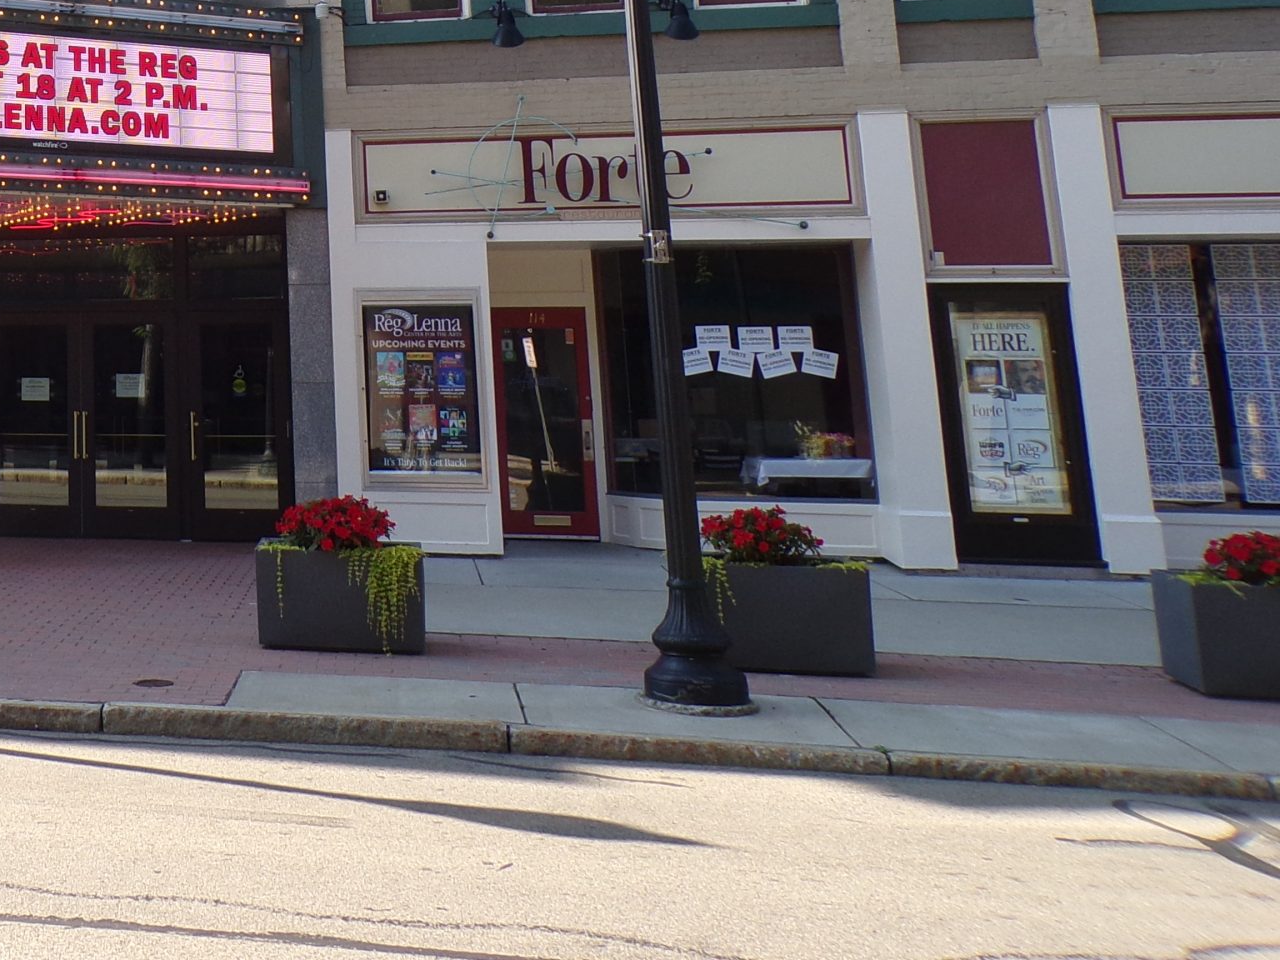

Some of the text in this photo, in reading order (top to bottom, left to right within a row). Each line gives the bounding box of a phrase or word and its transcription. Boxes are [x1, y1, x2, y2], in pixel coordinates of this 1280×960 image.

[21, 42, 58, 70] AT
[68, 45, 127, 75] THE
[138, 51, 198, 81] REG
[16, 73, 56, 101] 18
[67, 76, 104, 104] AT
[114, 80, 133, 106] 2
[145, 82, 208, 111] P.M.
[515, 139, 694, 204] Fore
[374, 313, 462, 337] Reg Lenna
[372, 339, 466, 349] UPCOMING EVENTS
[971, 333, 1036, 352] HERE.
